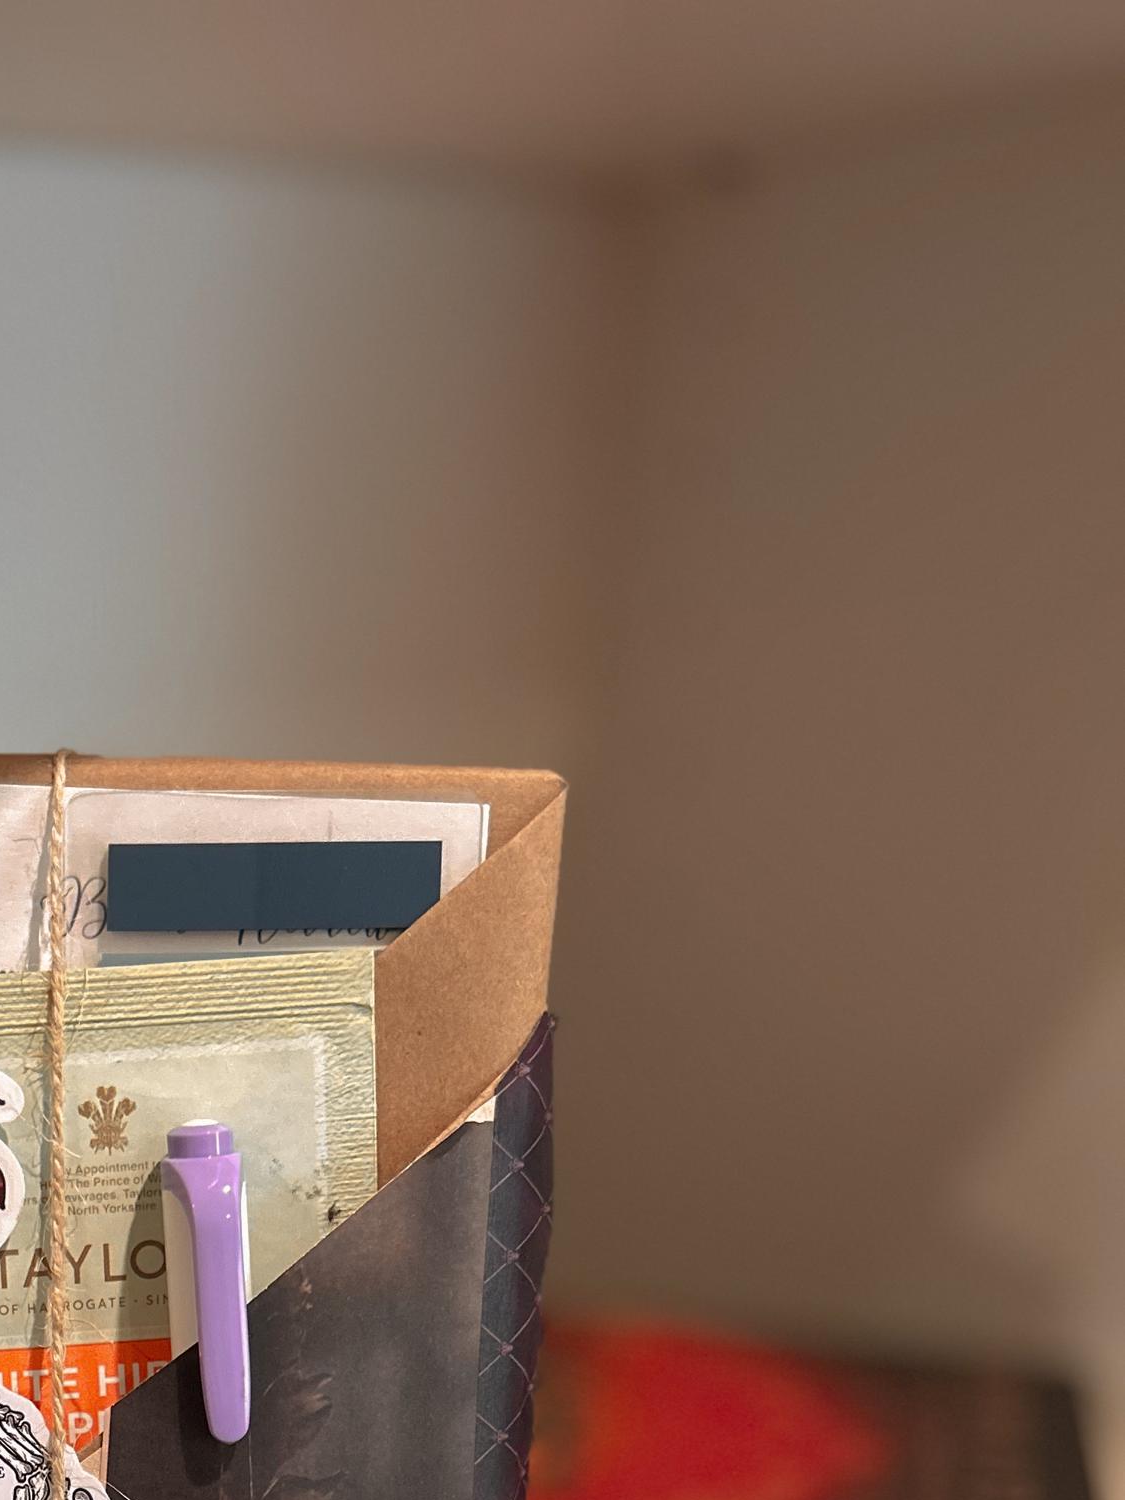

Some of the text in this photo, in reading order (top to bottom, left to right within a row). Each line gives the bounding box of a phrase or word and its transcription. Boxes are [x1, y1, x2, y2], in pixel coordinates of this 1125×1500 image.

[75, 1161, 149, 1177] Appointment
[67, 1178, 91, 1189] The
[94, 1176, 131, 1188] Prince
[133, 1175, 145, 1186] of
[67, 1201, 158, 1217] North Yorkshire
[27, 1296, 126, 1314] HAROGATE
